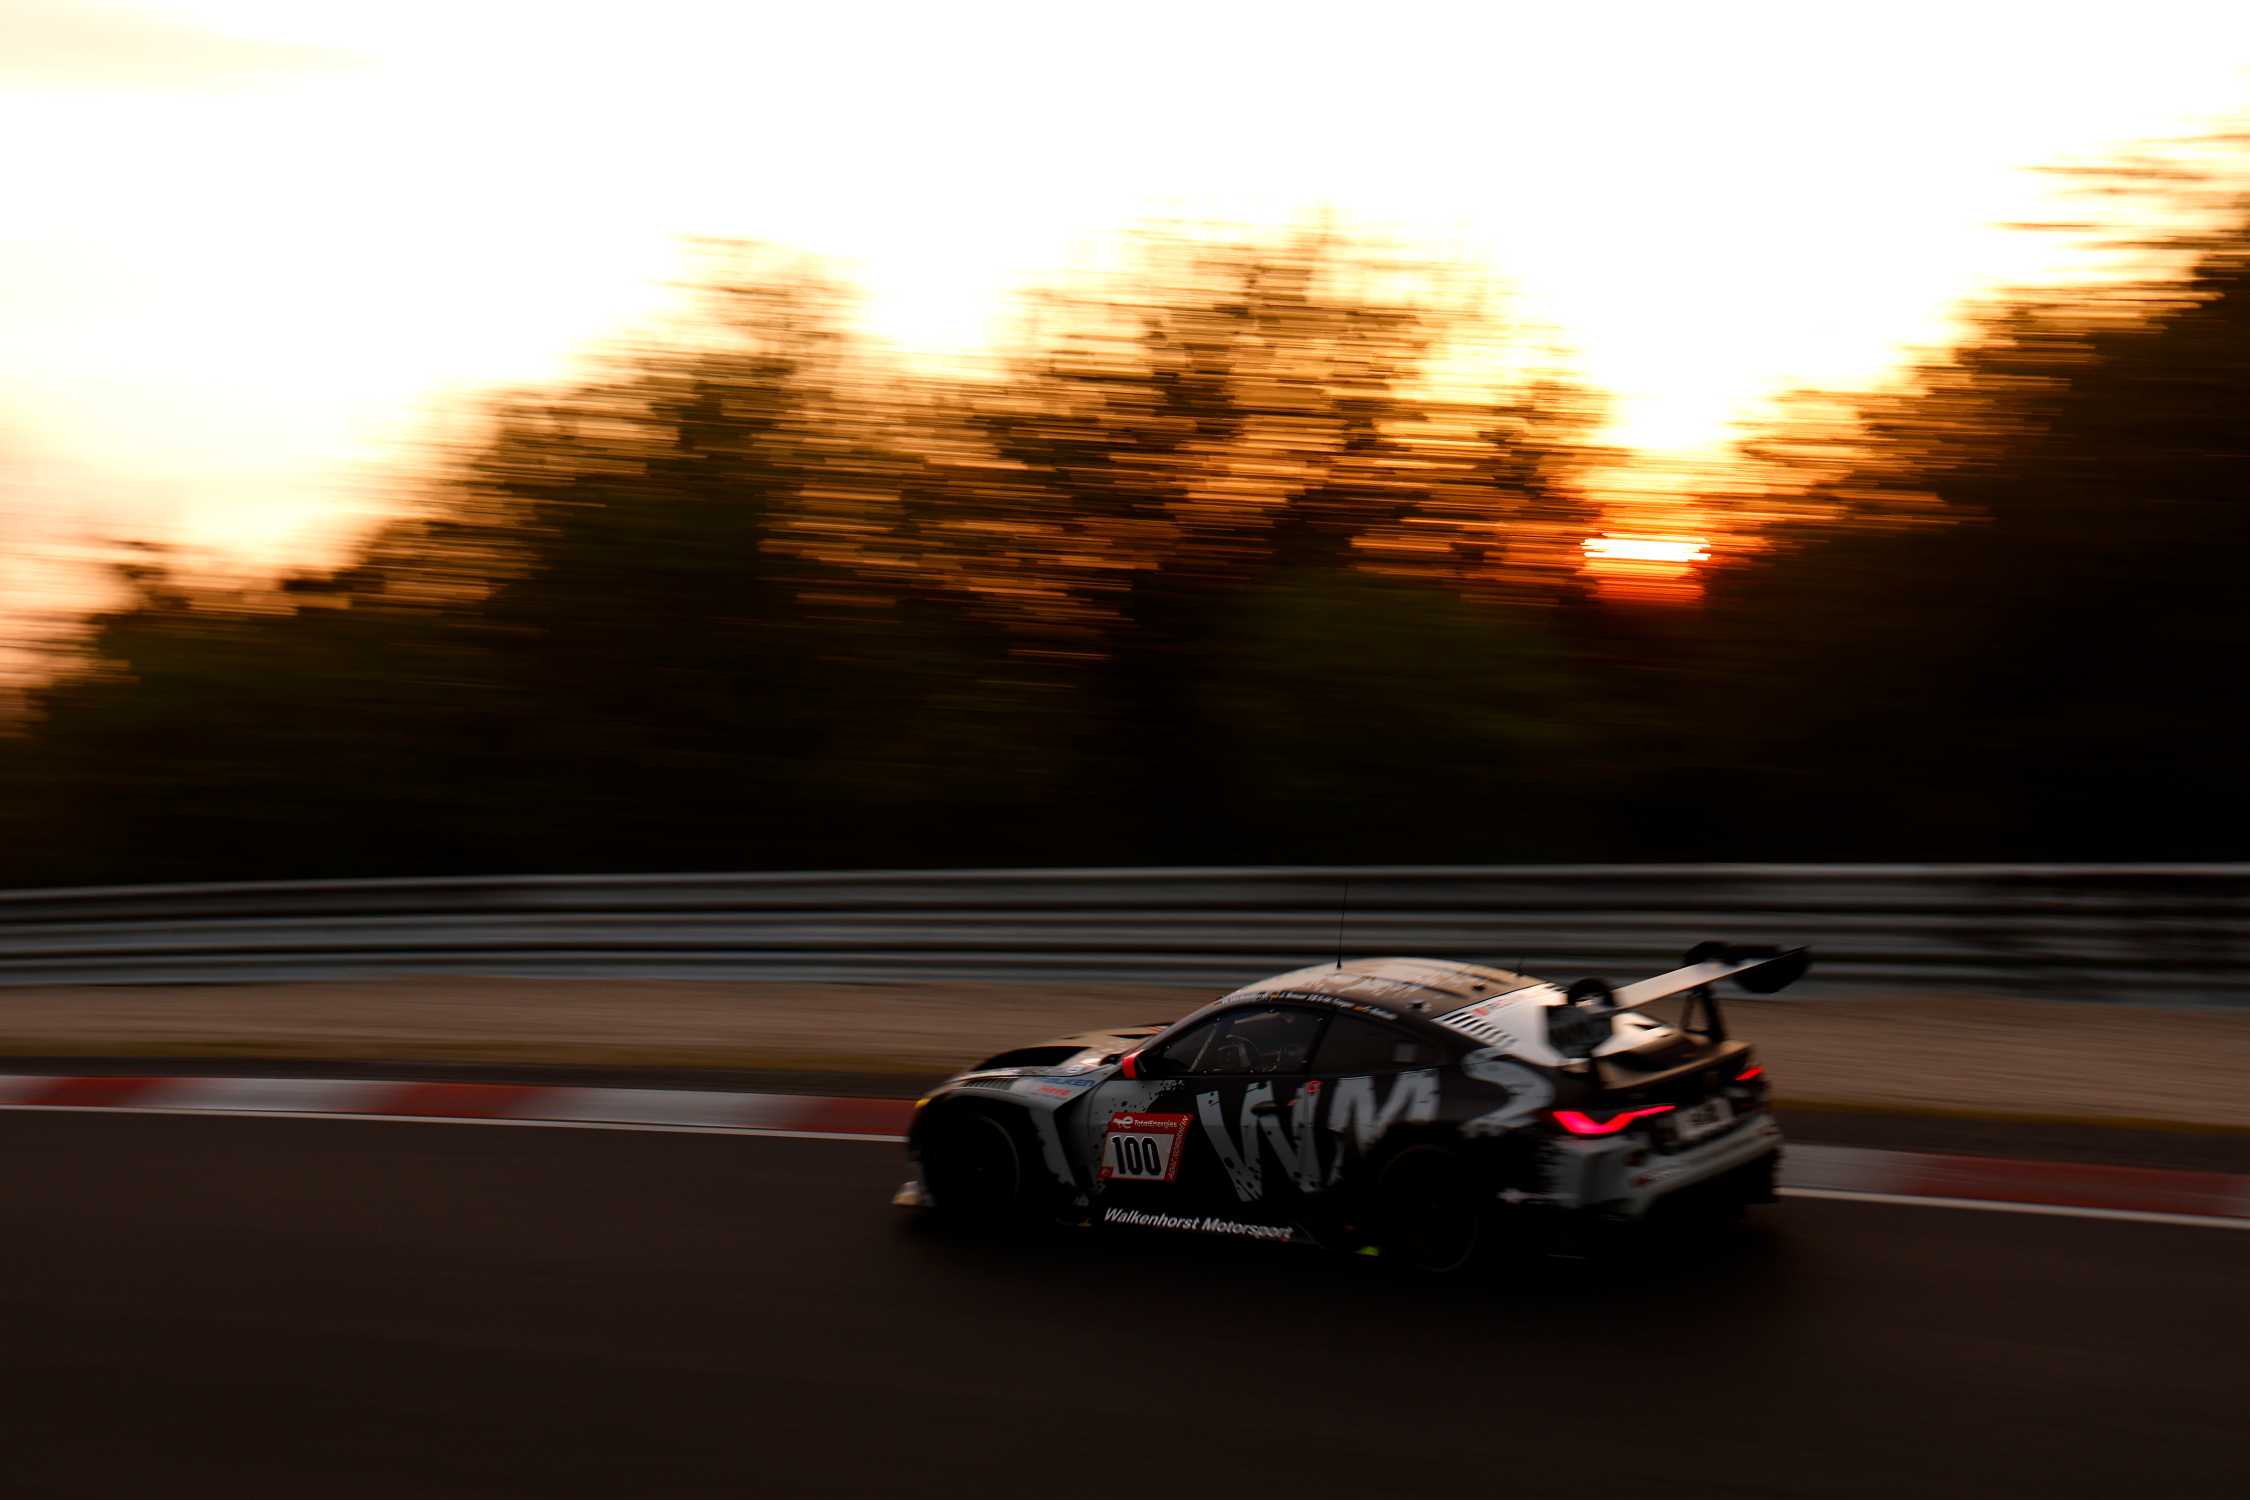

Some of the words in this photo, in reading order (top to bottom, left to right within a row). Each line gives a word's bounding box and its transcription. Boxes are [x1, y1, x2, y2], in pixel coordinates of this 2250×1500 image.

[1111, 1136, 1162, 1176] 100
[1104, 1206, 1201, 1232] Walkenhorst
[1200, 1215, 1295, 1240] Motorsport
